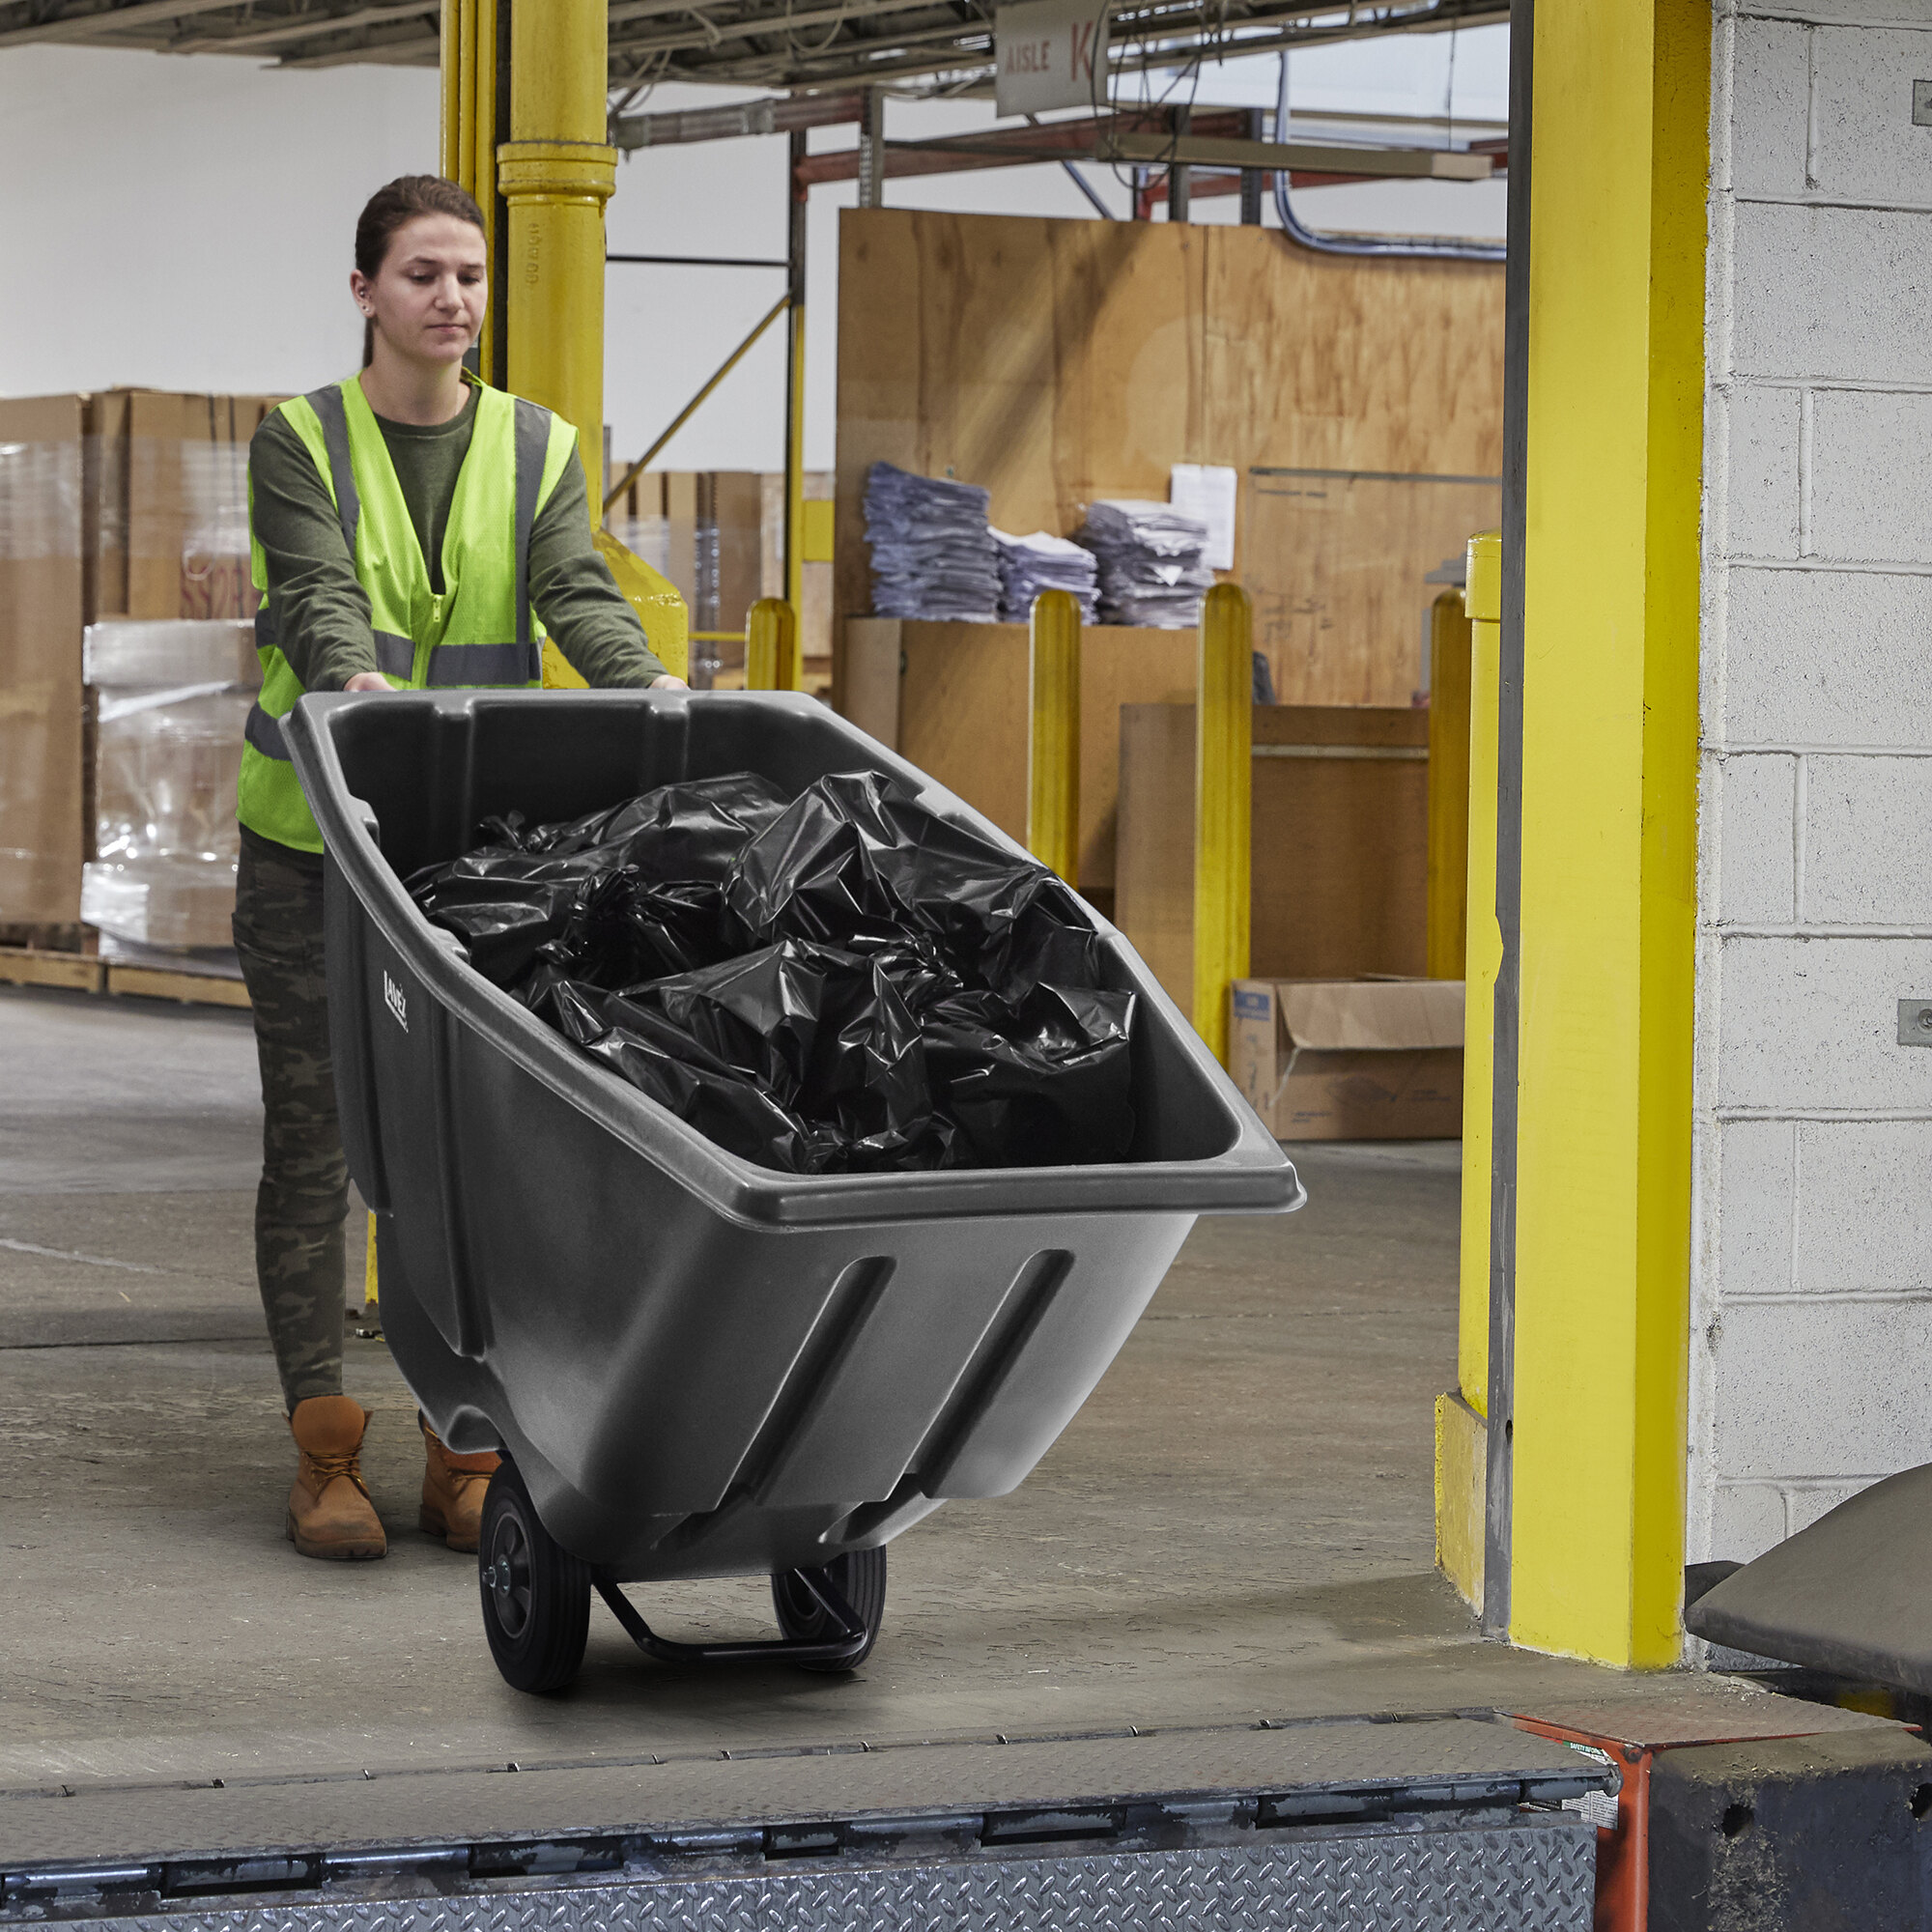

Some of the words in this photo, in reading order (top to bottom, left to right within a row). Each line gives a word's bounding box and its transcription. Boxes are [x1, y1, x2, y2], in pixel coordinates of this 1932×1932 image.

[1005, 40, 1050, 74] AISLE
[1070, 19, 1094, 82] K
[1570, 1742, 1585, 1752] SAFETY
